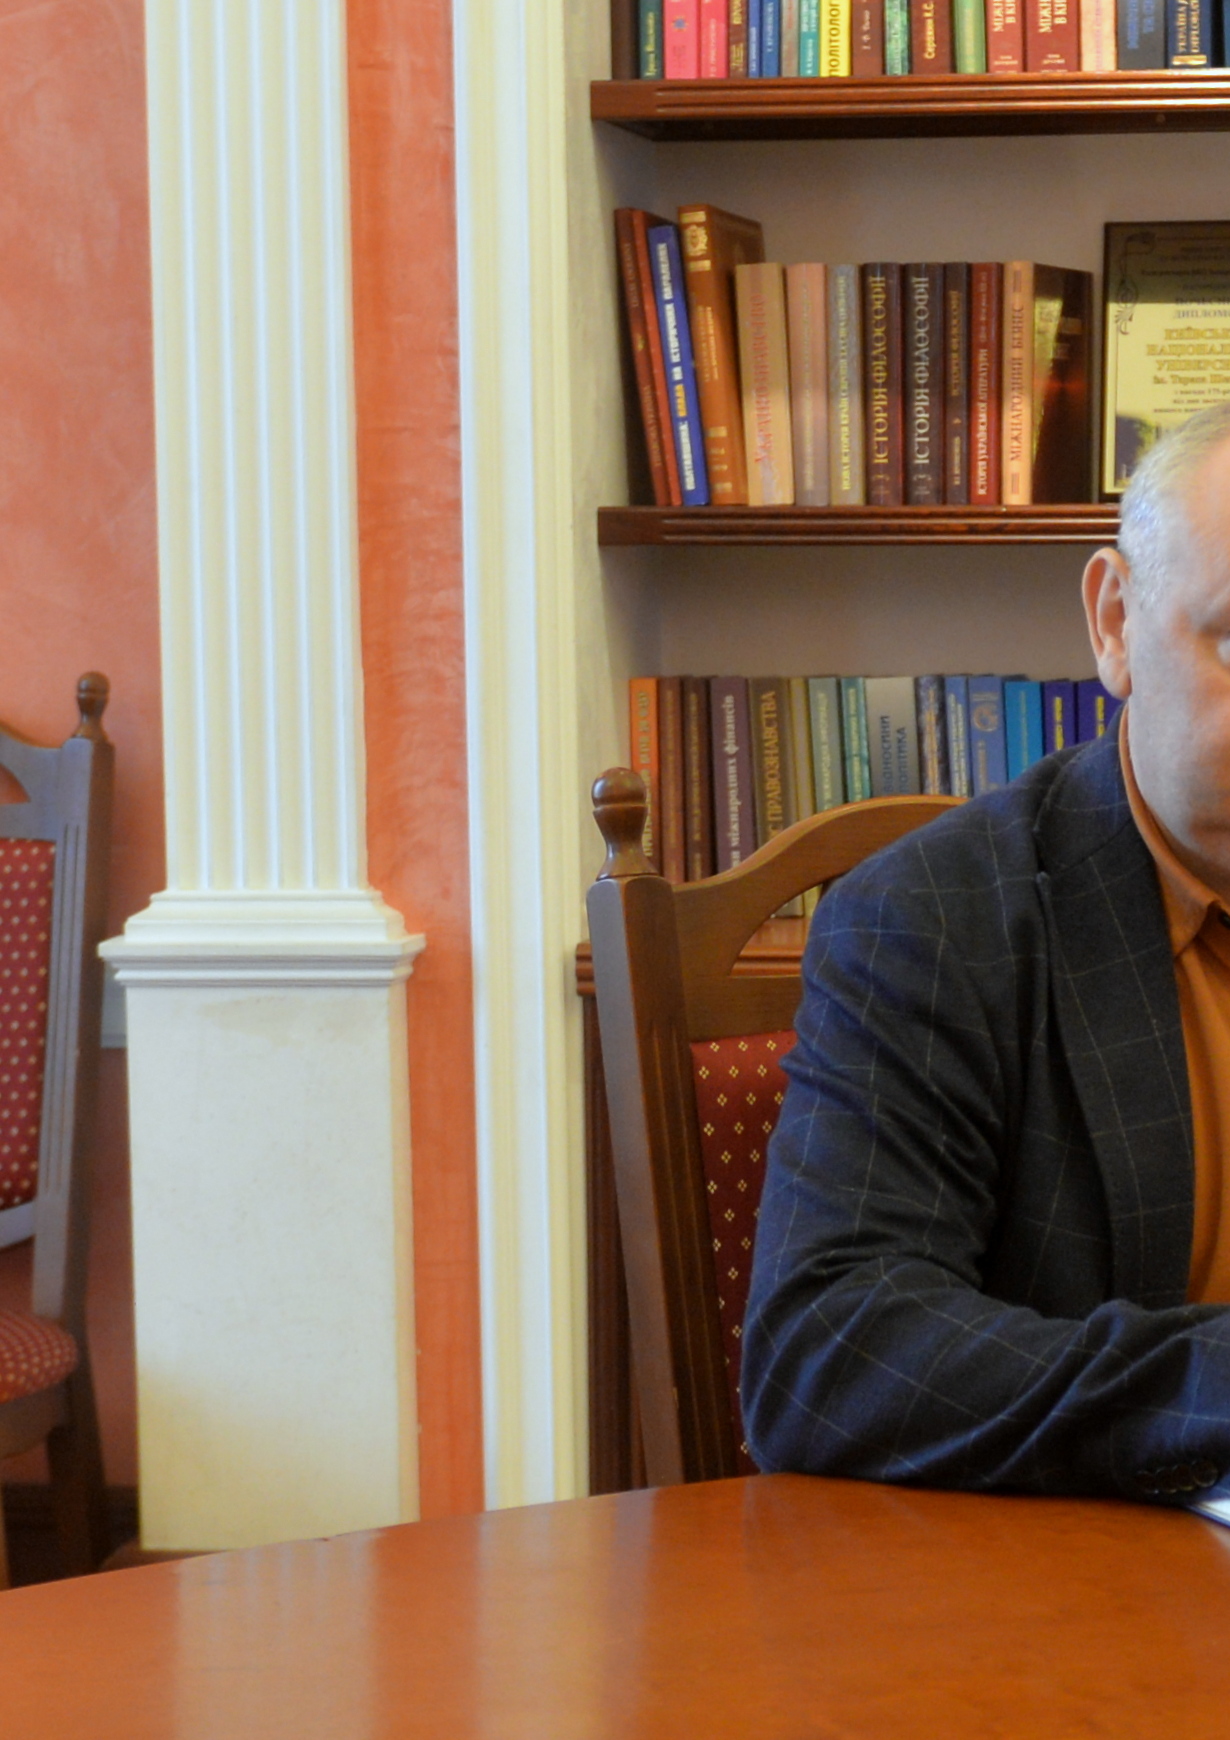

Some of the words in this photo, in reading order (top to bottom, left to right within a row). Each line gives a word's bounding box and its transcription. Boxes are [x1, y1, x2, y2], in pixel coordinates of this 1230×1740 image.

[657, 242, 673, 300] ПАРАЛЕЛЯХ
[665, 303, 680, 363] ІСТОРИЧНИХ
[869, 276, 887, 385] ФІЛОСОФІЇ
[913, 276, 929, 385] ФІЛОСОФІЇ
[1011, 303, 1024, 350] БІЗНЕС
[672, 365, 684, 381] НА
[978, 349, 989, 401] ЛІТЕРАТУРИ
[1170, 374, 1206, 385] Тараса
[874, 387, 888, 464] ІСТОРІЯ
[915, 387, 930, 464] ІСТОРІЯ
[977, 402, 990, 459] УКРАЇНСЬКОЇ
[1010, 356, 1023, 462] МІЖНАРОДНИЙ
[978, 460, 989, 495] ІСТОРІЯ
[722, 694, 739, 755] фінансів
[761, 690, 783, 821] ПРАВОЗНАВСТВА
[880, 715, 893, 793] ВІДНОСИНИ
[897, 727, 910, 793] ПОЛІТИКА
[729, 757, 742, 847] міжнародних
